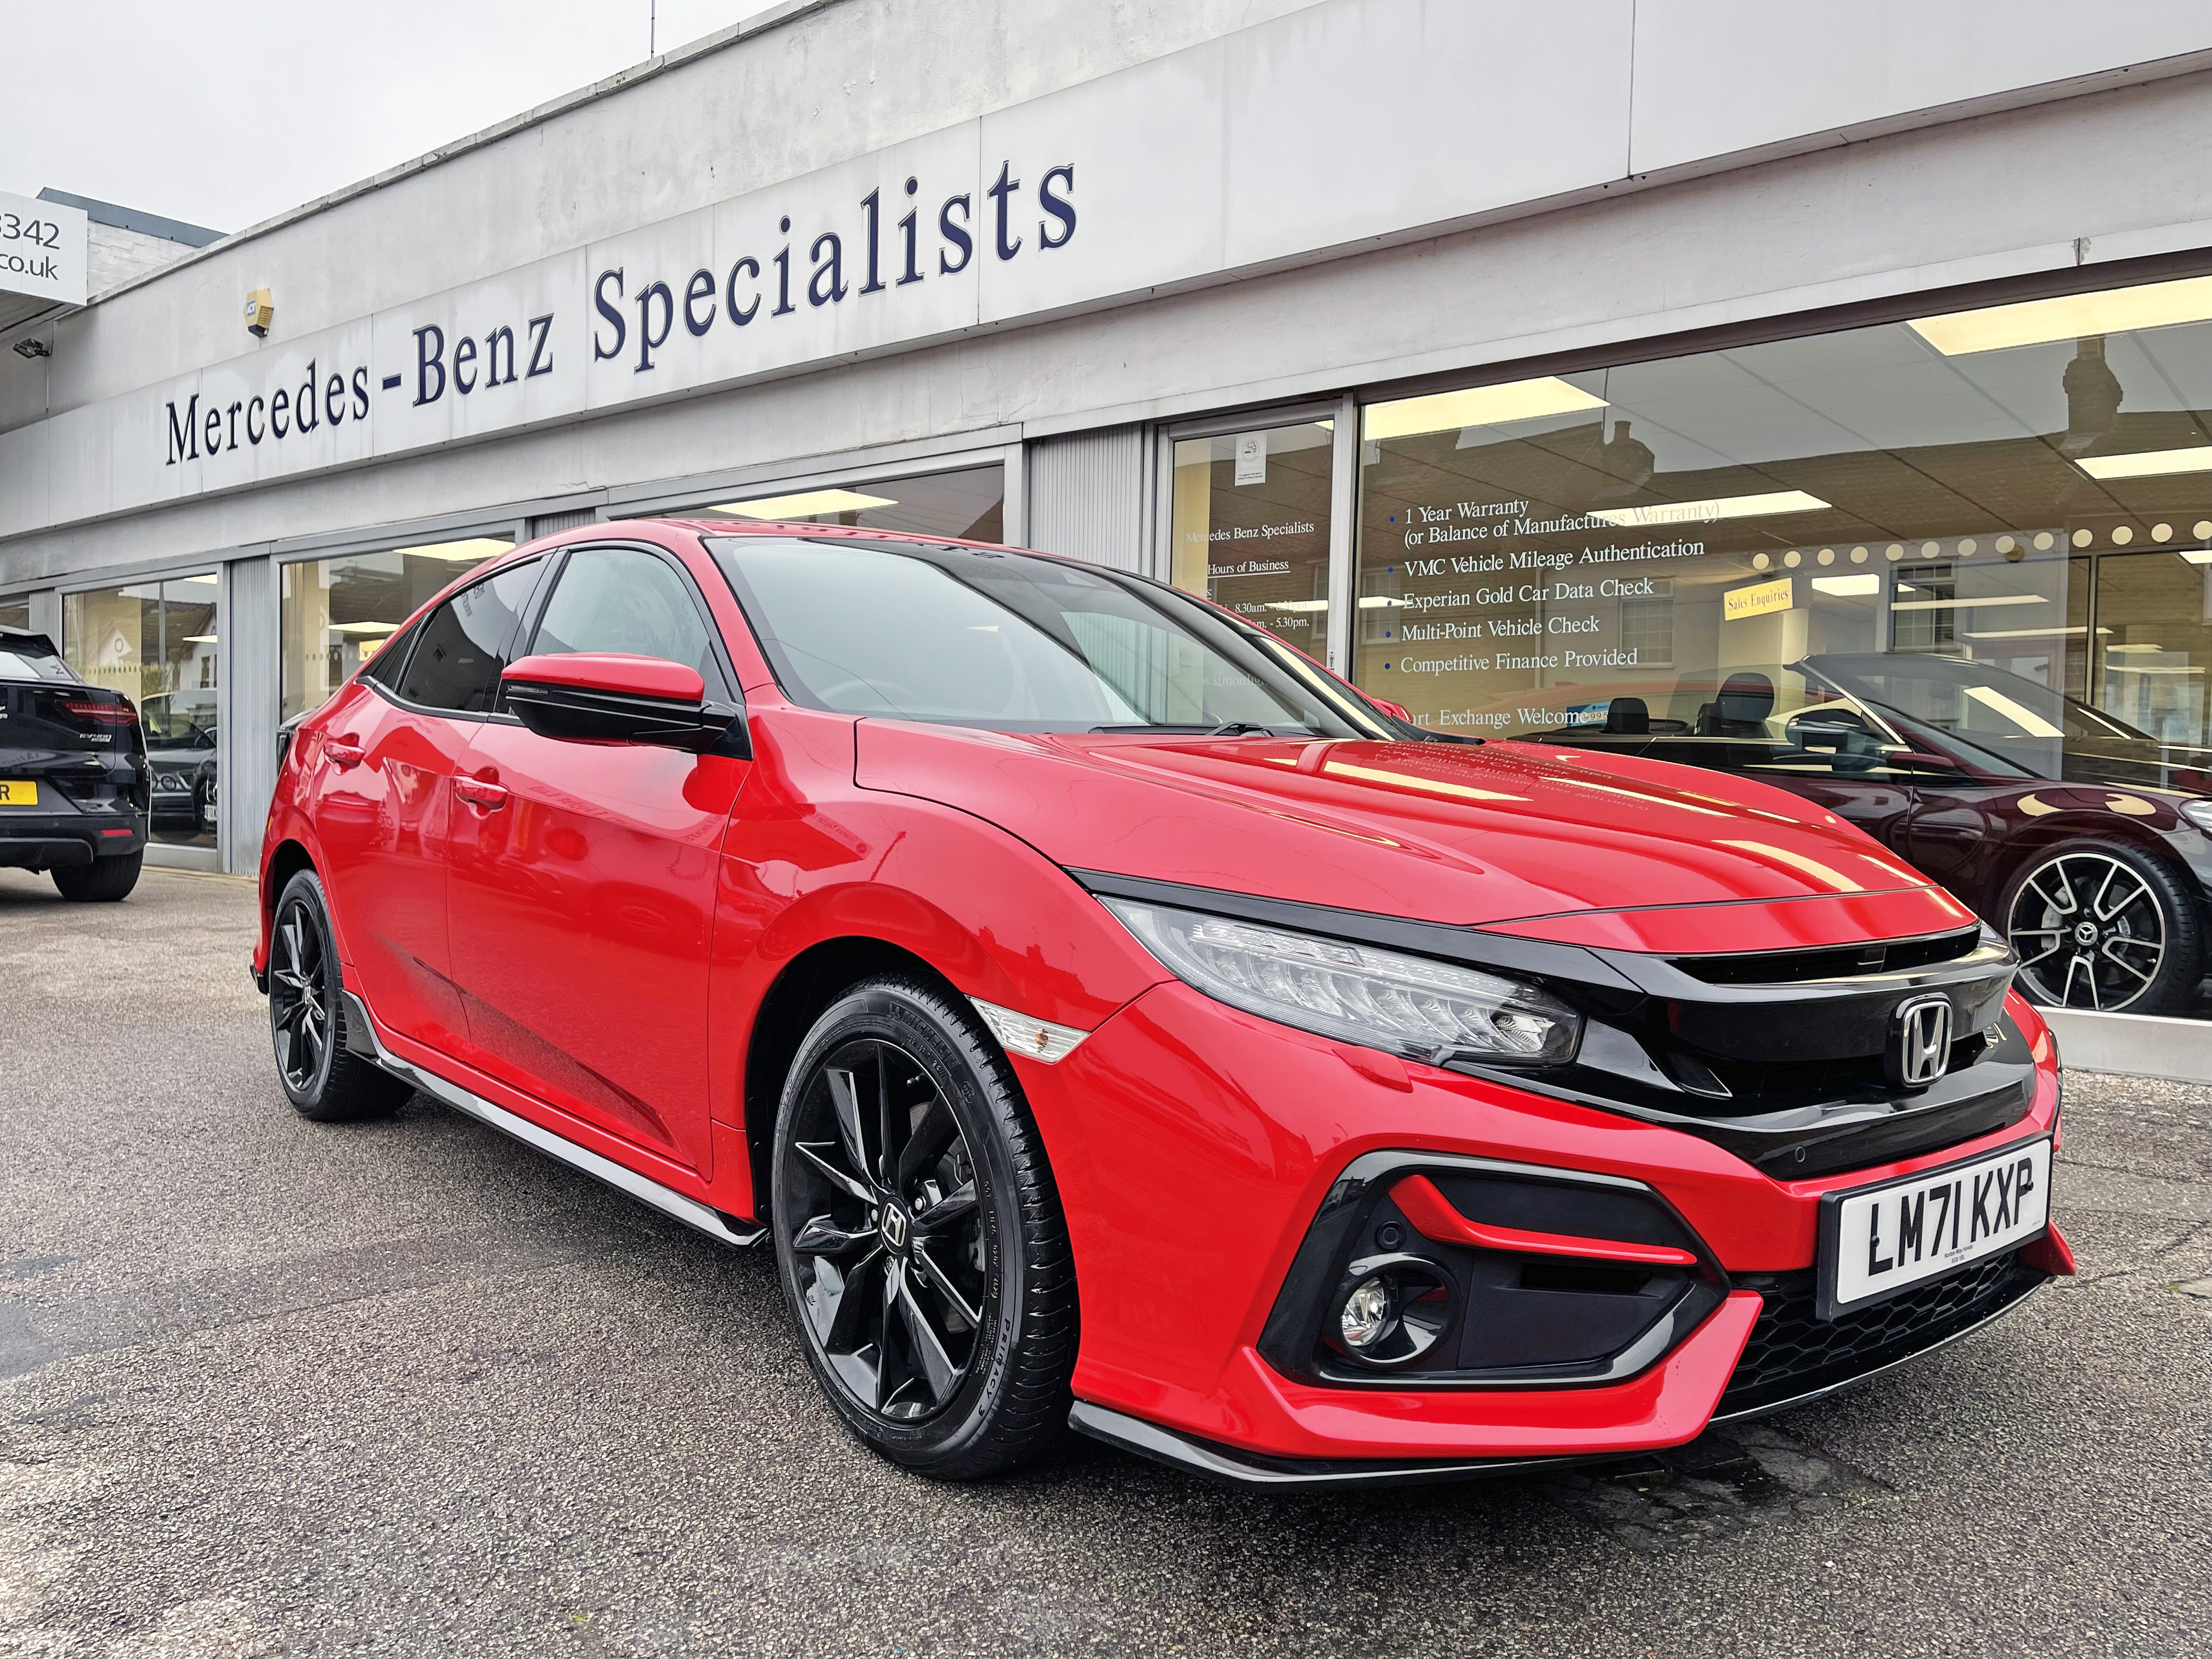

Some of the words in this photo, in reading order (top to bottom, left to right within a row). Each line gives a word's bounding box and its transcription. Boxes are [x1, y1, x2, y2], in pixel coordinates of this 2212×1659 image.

[0, 213, 60, 250] 342
[166, 313, 555, 466] Mercedes-Benz
[594, 159, 1077, 375] Specialists
[1404, 528, 1424, 550] (or
[1428, 525, 1488, 543] Balance
[1493, 520, 1510, 537] of
[1513, 513, 1626, 535] Manufactures
[1632, 499, 1719, 524] Warranty)
[1406, 508, 1413, 524] 1
[1418, 506, 1452, 523] Year
[1457, 499, 1529, 519] Warranty
[1186, 529, 1231, 544] Mercedes
[1234, 527, 1259, 539] Benz
[1261, 521, 1314, 539] Specialists
[1207, 564, 1234, 575] Hours
[1237, 561, 1247, 573] of
[1249, 560, 1289, 572] Business
[1404, 558, 1446, 577] VMC
[1450, 554, 1504, 573] Vehicle
[1509, 550, 1573, 571] Mileage
[1578, 538, 1705, 564] Authentication
[1235, 602, 1267, 613] 8.30am.
[1402, 590, 1470, 613] Experian
[1476, 586, 1513, 605] Gold
[1519, 584, 1549, 602] Car
[1554, 583, 1594, 600] Data
[1600, 577, 1654, 597] Check
[1729, 596, 1748, 611] Sales
[1751, 588, 1788, 607] Enquiries
[1276, 617, 1310, 630] 5.30pm.
[1402, 622, 1482, 641] Multi-Point
[1487, 618, 1543, 637] Vehicle
[1548, 615, 1600, 634] Check
[1400, 654, 1489, 676] Competitive
[1495, 652, 1558, 670] Finance
[1564, 648, 1638, 668] Provided
[1412, 712, 1430, 726] art
[1439, 709, 1511, 730] Exchange
[1517, 707, 1589, 725] Welcome
[901, 1009, 959, 1069] MICHELIN
[1867, 1180, 1962, 1277] LM71
[1970, 1157, 2033, 1243] KXP
[986, 1318, 1011, 1400] PRIMACY
[978, 1404, 985, 1417] 3
